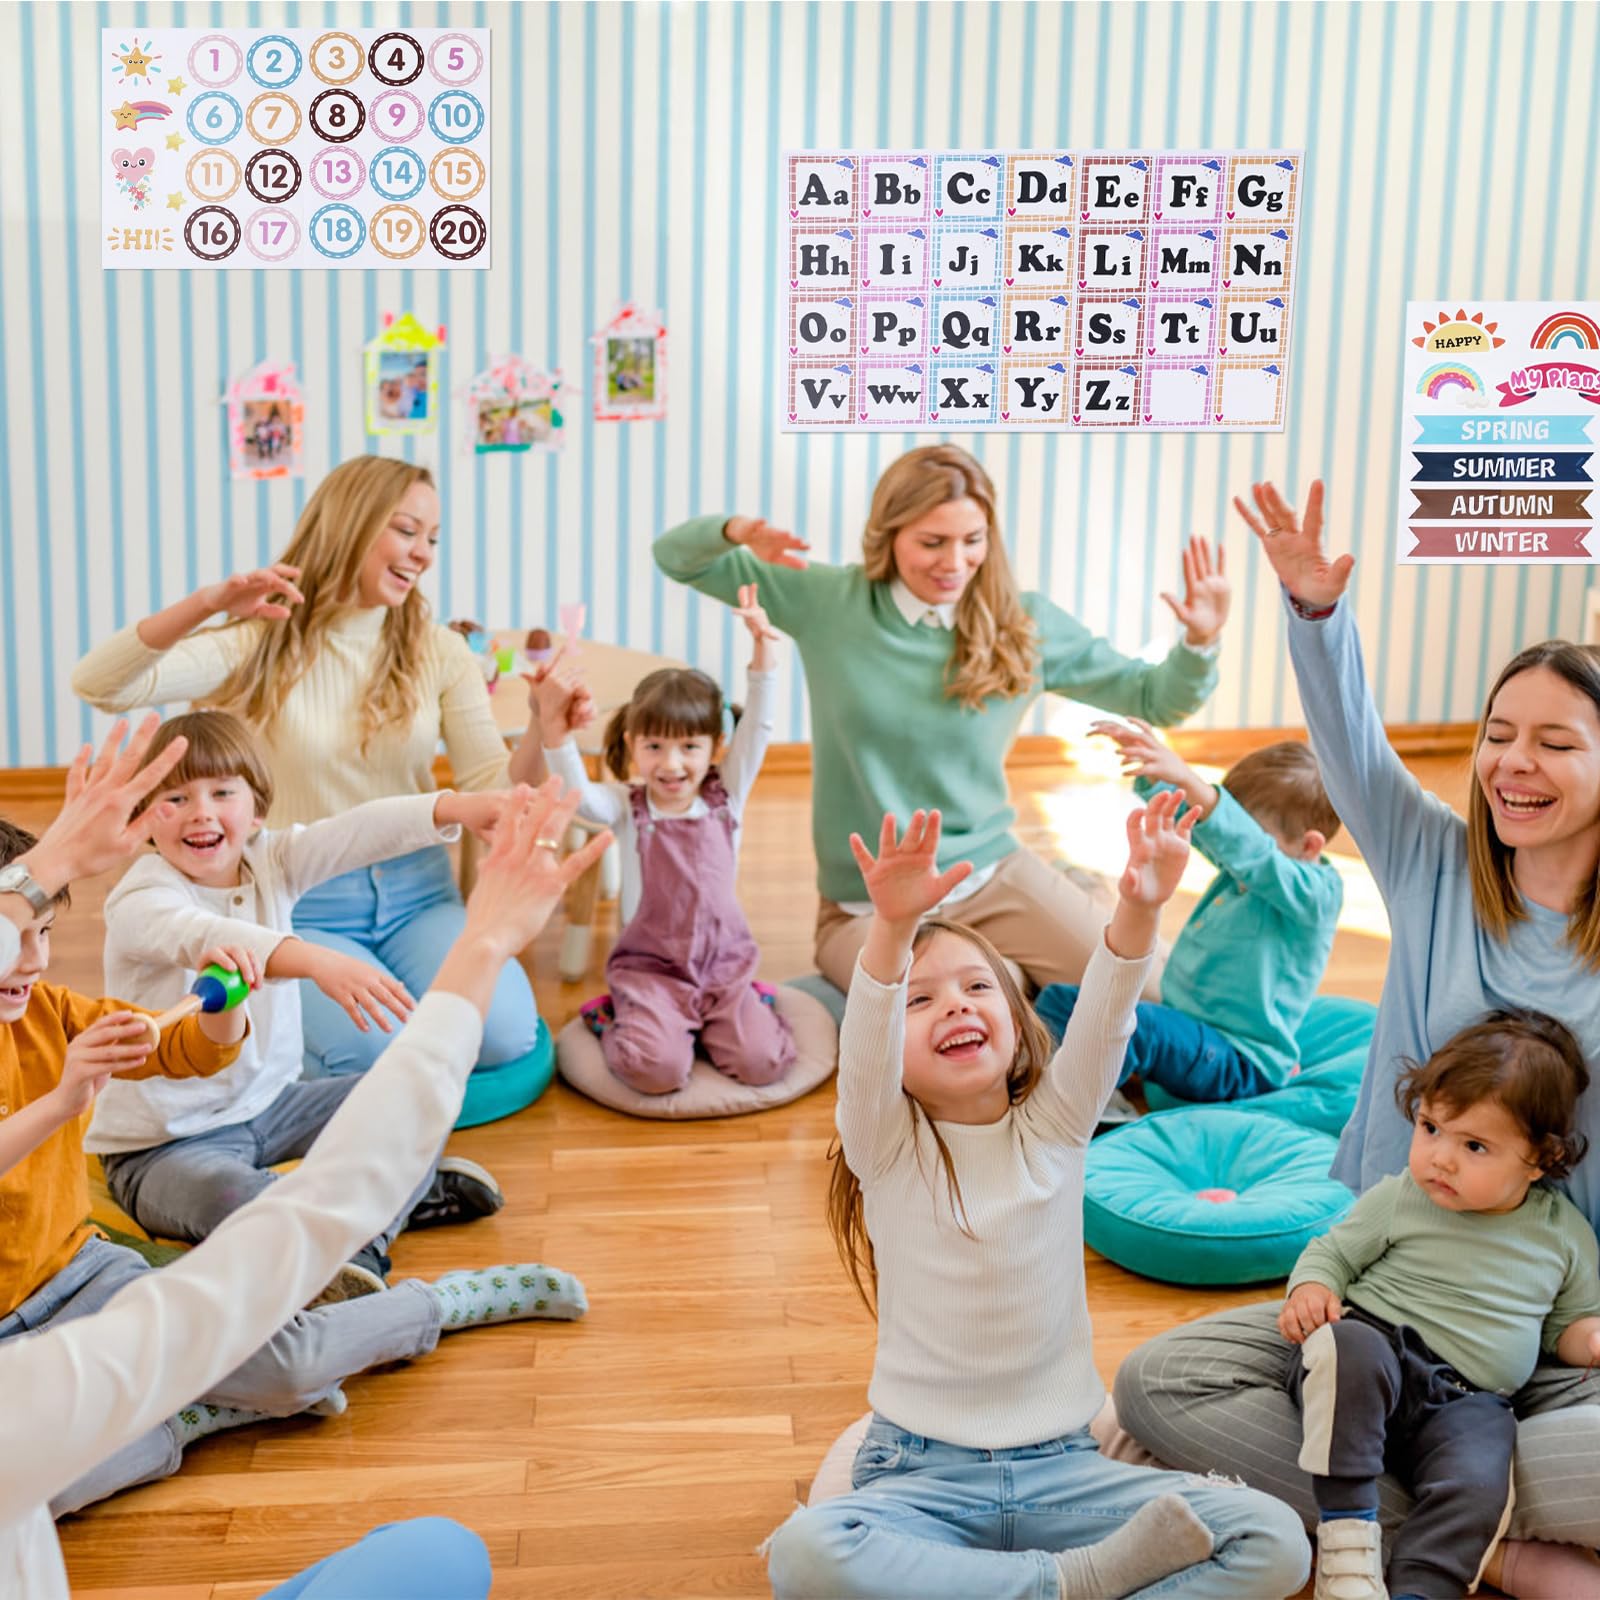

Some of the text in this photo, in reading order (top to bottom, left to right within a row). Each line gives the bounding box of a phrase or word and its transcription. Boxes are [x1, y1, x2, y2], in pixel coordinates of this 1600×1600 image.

[210, 46, 464, 72] 1 2 3 4 5
[206, 103, 471, 129] 6 7 8 9 10
[201, 160, 472, 188] 11 12 13 14 15
[799, 171, 1283, 211] Aa Bb Cc Dd Ee Ff Gg
[123, 229, 159, 250] HI!
[199, 218, 476, 245] 16 17 18 19 20
[800, 245, 849, 275] Hh
[1018, 245, 1064, 272] Kk
[1160, 248, 1211, 274] Mm
[1233, 245, 1282, 275] Nn
[800, 311, 1277, 348] Oo Pp Qq Rr Ss Tt Uu
[1435, 335, 1482, 349] HAPPY
[1511, 370, 1541, 389] My
[801, 379, 846, 409] Vv
[940, 378, 989, 408] Xx
[1015, 377, 1058, 411] Yy
[1085, 380, 1129, 410] Zz
[1461, 420, 1549, 440] SPRING
[1453, 457, 1556, 478] SUMMER
[1451, 495, 1553, 516] AUTUMN
[1455, 531, 1549, 552] WINTER
